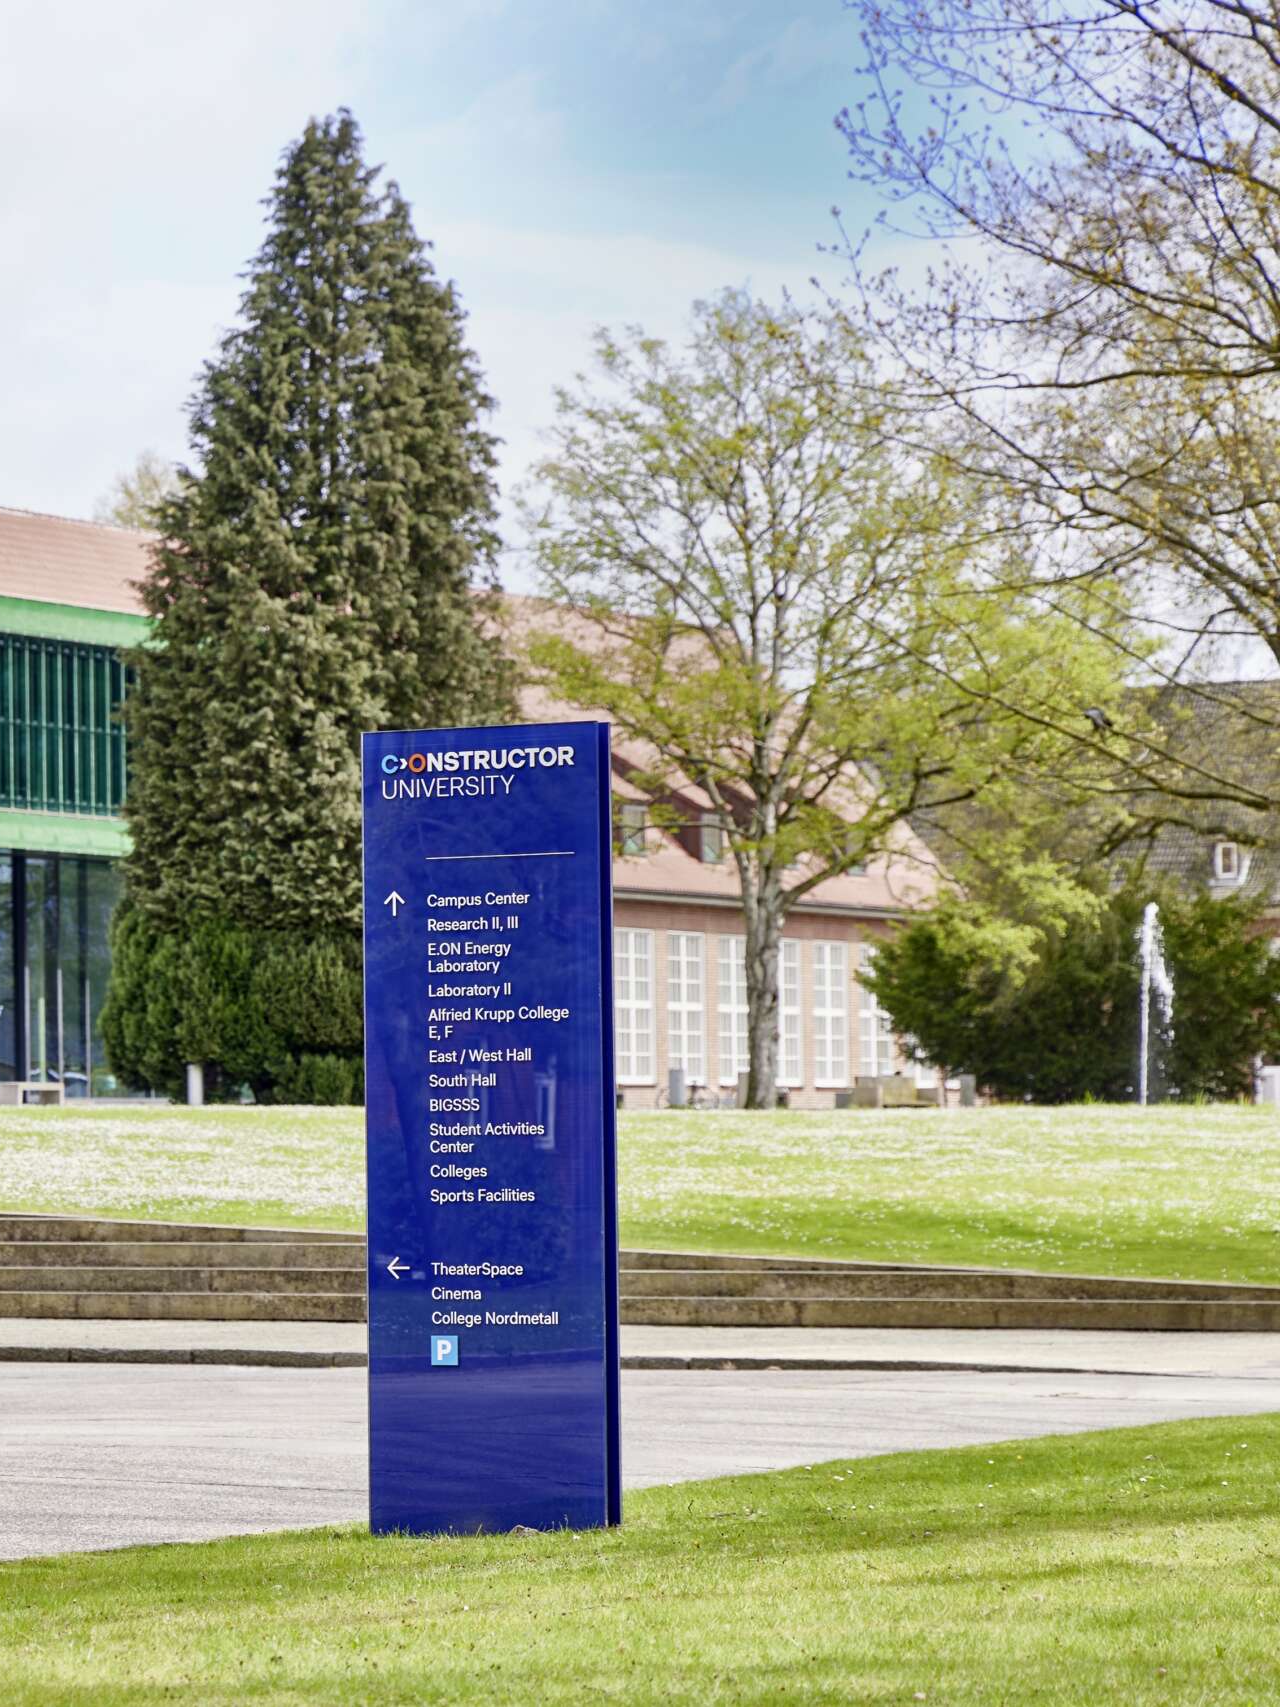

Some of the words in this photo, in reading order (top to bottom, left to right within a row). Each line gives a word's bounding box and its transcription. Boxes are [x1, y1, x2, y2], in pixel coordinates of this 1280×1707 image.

[381, 774, 516, 800] UNIVERSITY
[426, 893, 482, 910] Campus
[484, 891, 531, 906] Center
[427, 916, 489, 932] Research
[491, 916, 504, 932] II,
[507, 915, 519, 929] III
[427, 941, 461, 956] E.ON
[464, 941, 512, 958] Energy
[427, 959, 501, 975] Laboratory
[428, 983, 501, 999] Laboratory
[503, 982, 512, 996] II
[427, 1007, 472, 1022] Alfried
[474, 1007, 516, 1023] Krupp
[518, 1005, 570, 1022] College
[428, 1025, 441, 1041] E,
[444, 1025, 454, 1039] F
[428, 1049, 458, 1063] East
[468, 1048, 503, 1062] West
[506, 1047, 532, 1062] Hall
[428, 1073, 468, 1088] South
[470, 1072, 497, 1087] Hall
[429, 1097, 480, 1112] BIGSSS
[429, 1121, 482, 1137] Student
[484, 1121, 545, 1136] Activities
[429, 1139, 475, 1154] Center
[429, 1164, 488, 1181] Colleges
[430, 1188, 475, 1205] Sports
[477, 1187, 536, 1202] Facilities
[430, 1261, 524, 1279] TheaterSpace
[431, 1286, 482, 1301] Cinema
[431, 1310, 482, 1328] College
[485, 1311, 559, 1325] Nordmetall
